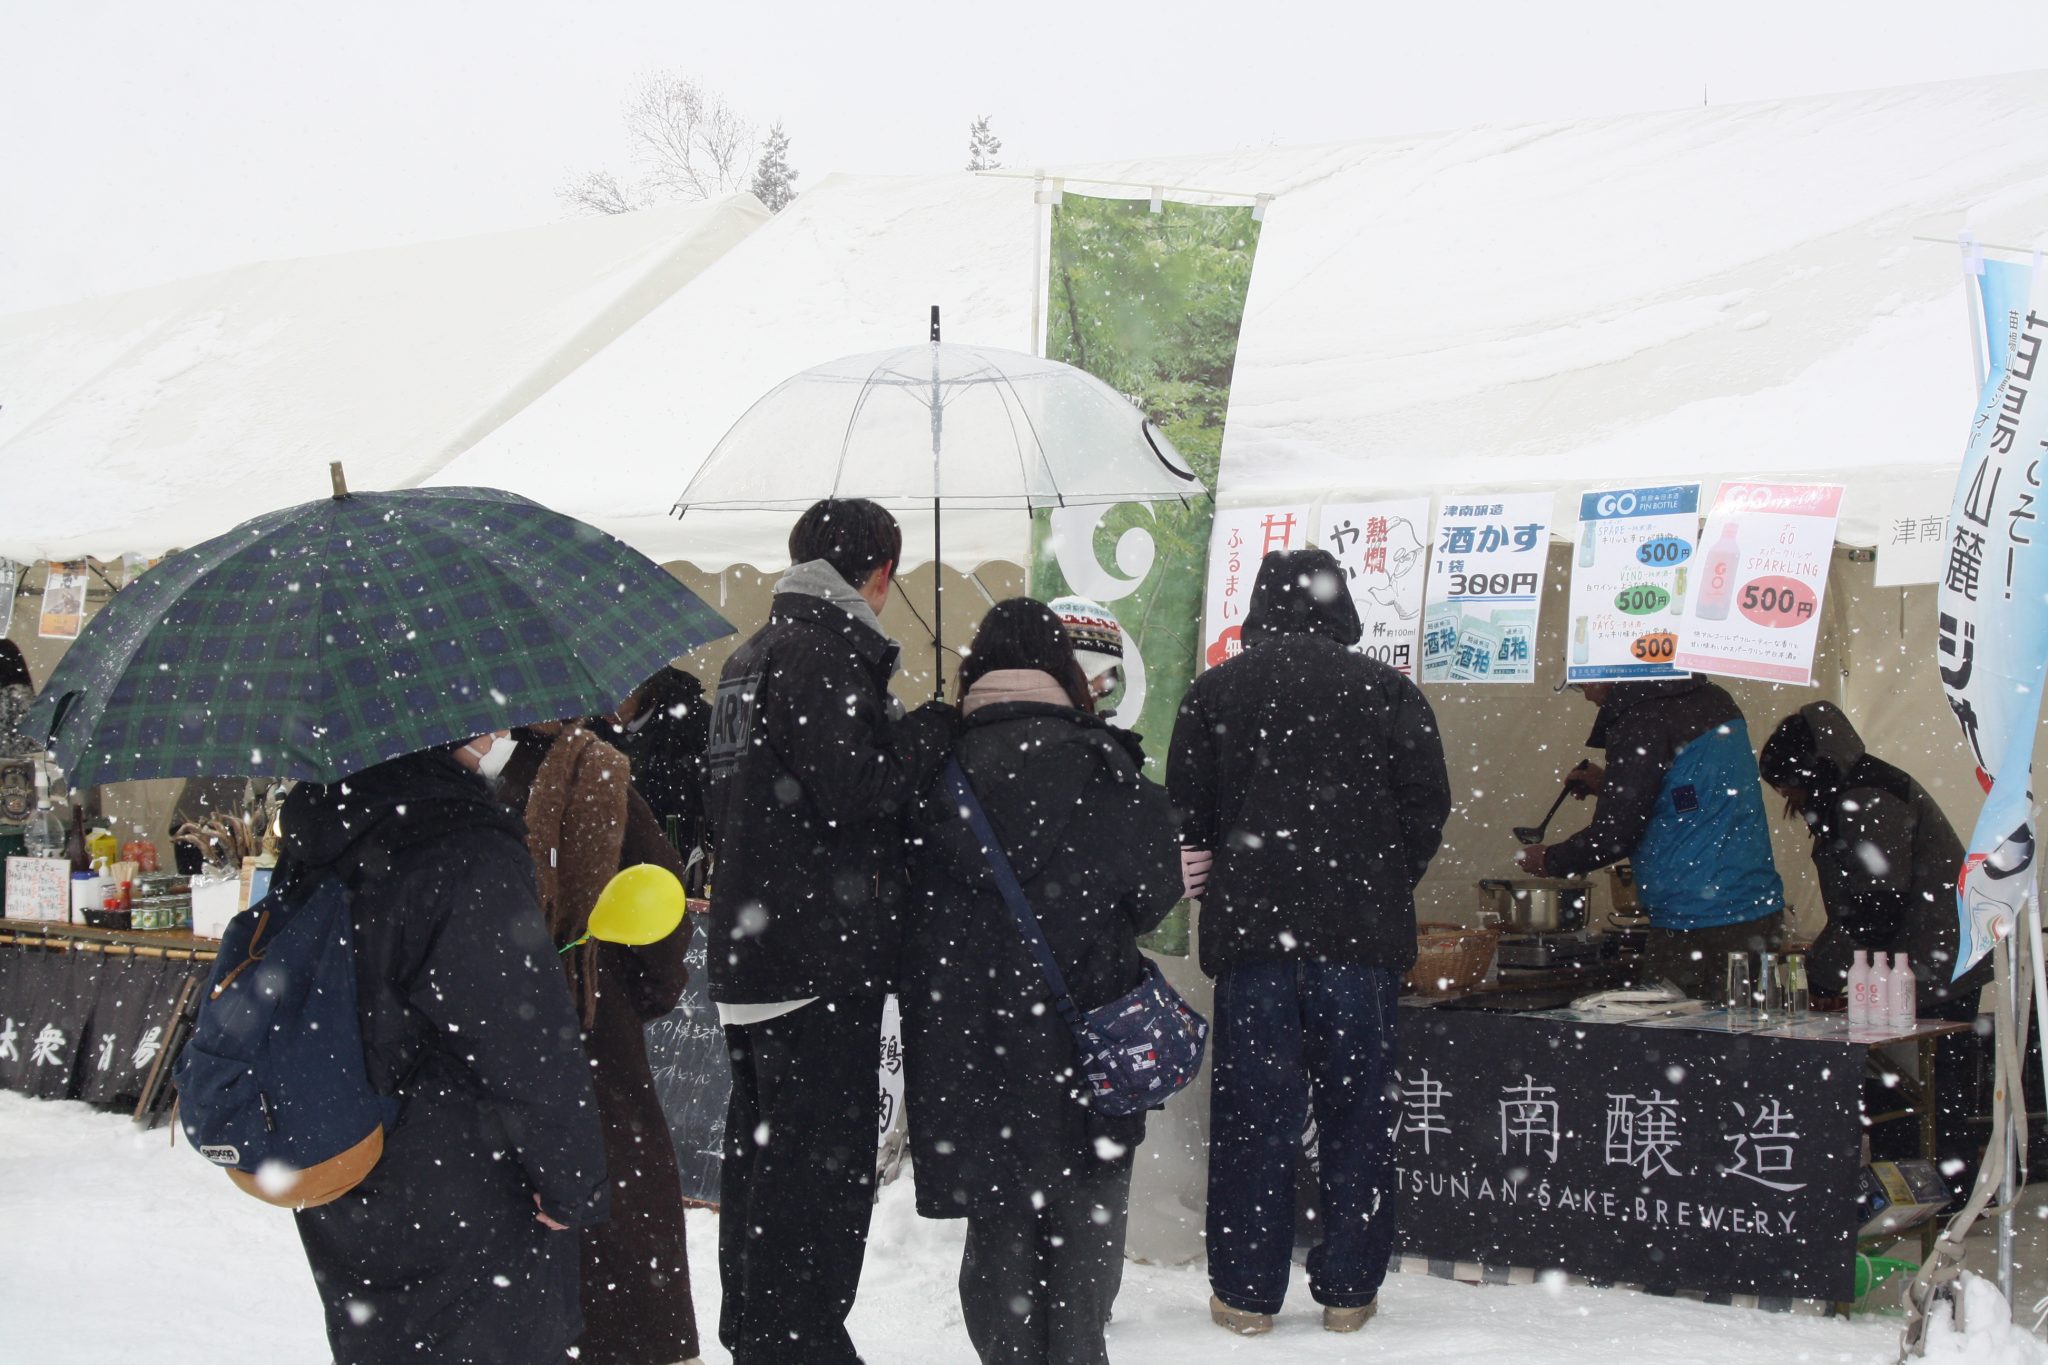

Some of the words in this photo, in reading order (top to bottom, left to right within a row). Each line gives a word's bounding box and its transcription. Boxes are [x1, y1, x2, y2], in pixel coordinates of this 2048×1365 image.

[1442, 504, 1504, 518] 津南醸造
[1597, 493, 1637, 516] GO
[1653, 500, 1678, 510] BOTTLE
[1438, 523, 1546, 555] 酒かす
[1891, 514, 1951, 546] 津南
[1363, 515, 1389, 575] 熱燗
[1640, 542, 1690, 563] 500円
[1222, 528, 1244, 619] ふるまい
[1436, 559, 1465, 574] 1袋
[1746, 557, 1819, 577] SPARKLING
[1447, 573, 1538, 595] 300円
[1617, 590, 1668, 611] 500円
[1742, 585, 1814, 619] 500円
[1391, 1067, 1808, 1193] 津南醸造
[1394, 1166, 1520, 1203] TSUNAN
[1538, 1182, 1617, 1218] SAKE
[1634, 1196, 1798, 1235] BREWERY
